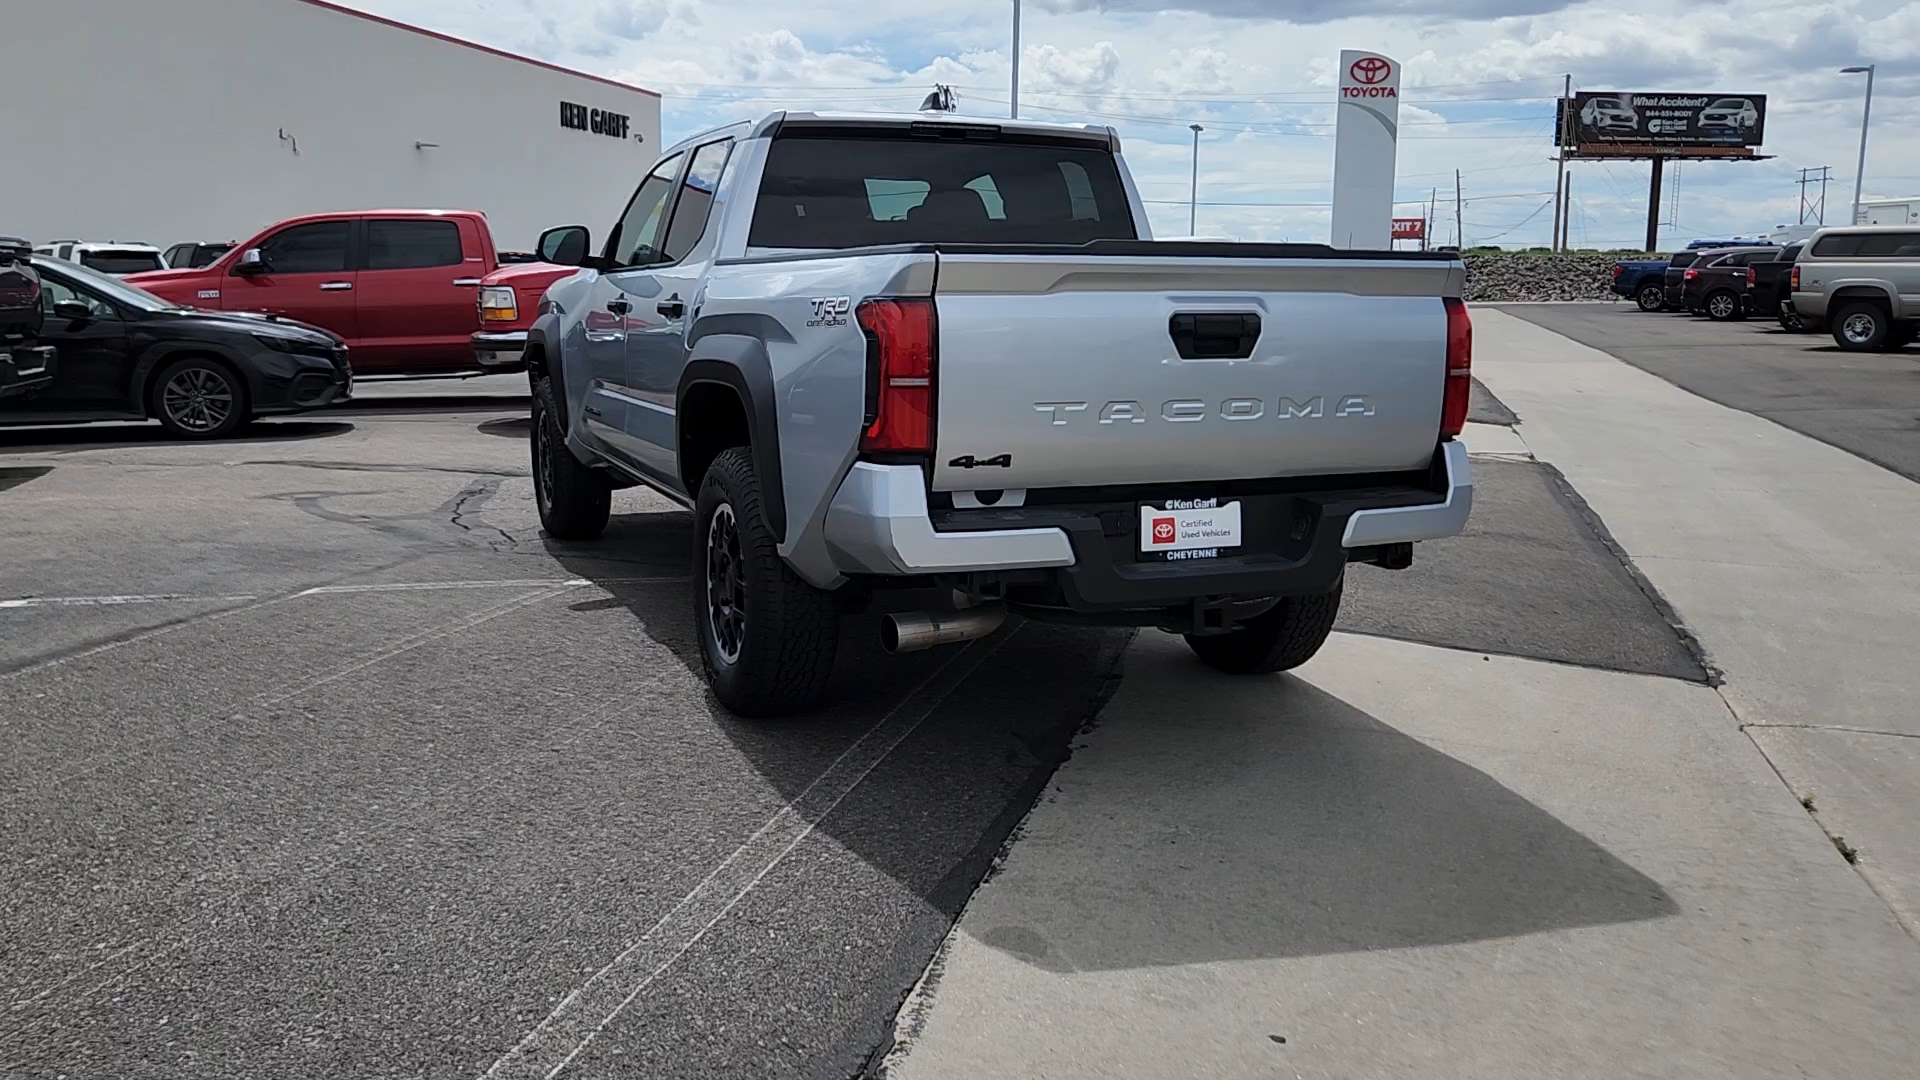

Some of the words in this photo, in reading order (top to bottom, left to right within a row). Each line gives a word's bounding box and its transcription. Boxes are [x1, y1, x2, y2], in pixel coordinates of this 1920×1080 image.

[1341, 86, 1397, 98] TOYOTA
[1633, 96, 1658, 106] What
[1660, 97, 1708, 107] Accident?
[560, 101, 588, 131] KEN
[590, 108, 630, 140] GARFF
[1392, 221, 1412, 232] XIT
[1413, 221, 1422, 232] 7
[811, 296, 851, 320] TRD
[1033, 394, 1376, 425] TACOMA
[1174, 499, 1192, 509] Ken
[1193, 498, 1217, 509] Garff
[1180, 519, 1213, 528] Certified
[1181, 531, 1200, 539] Used
[1201, 529, 1231, 538] Vehicles
[1166, 548, 1218, 560] CHEYENNE
